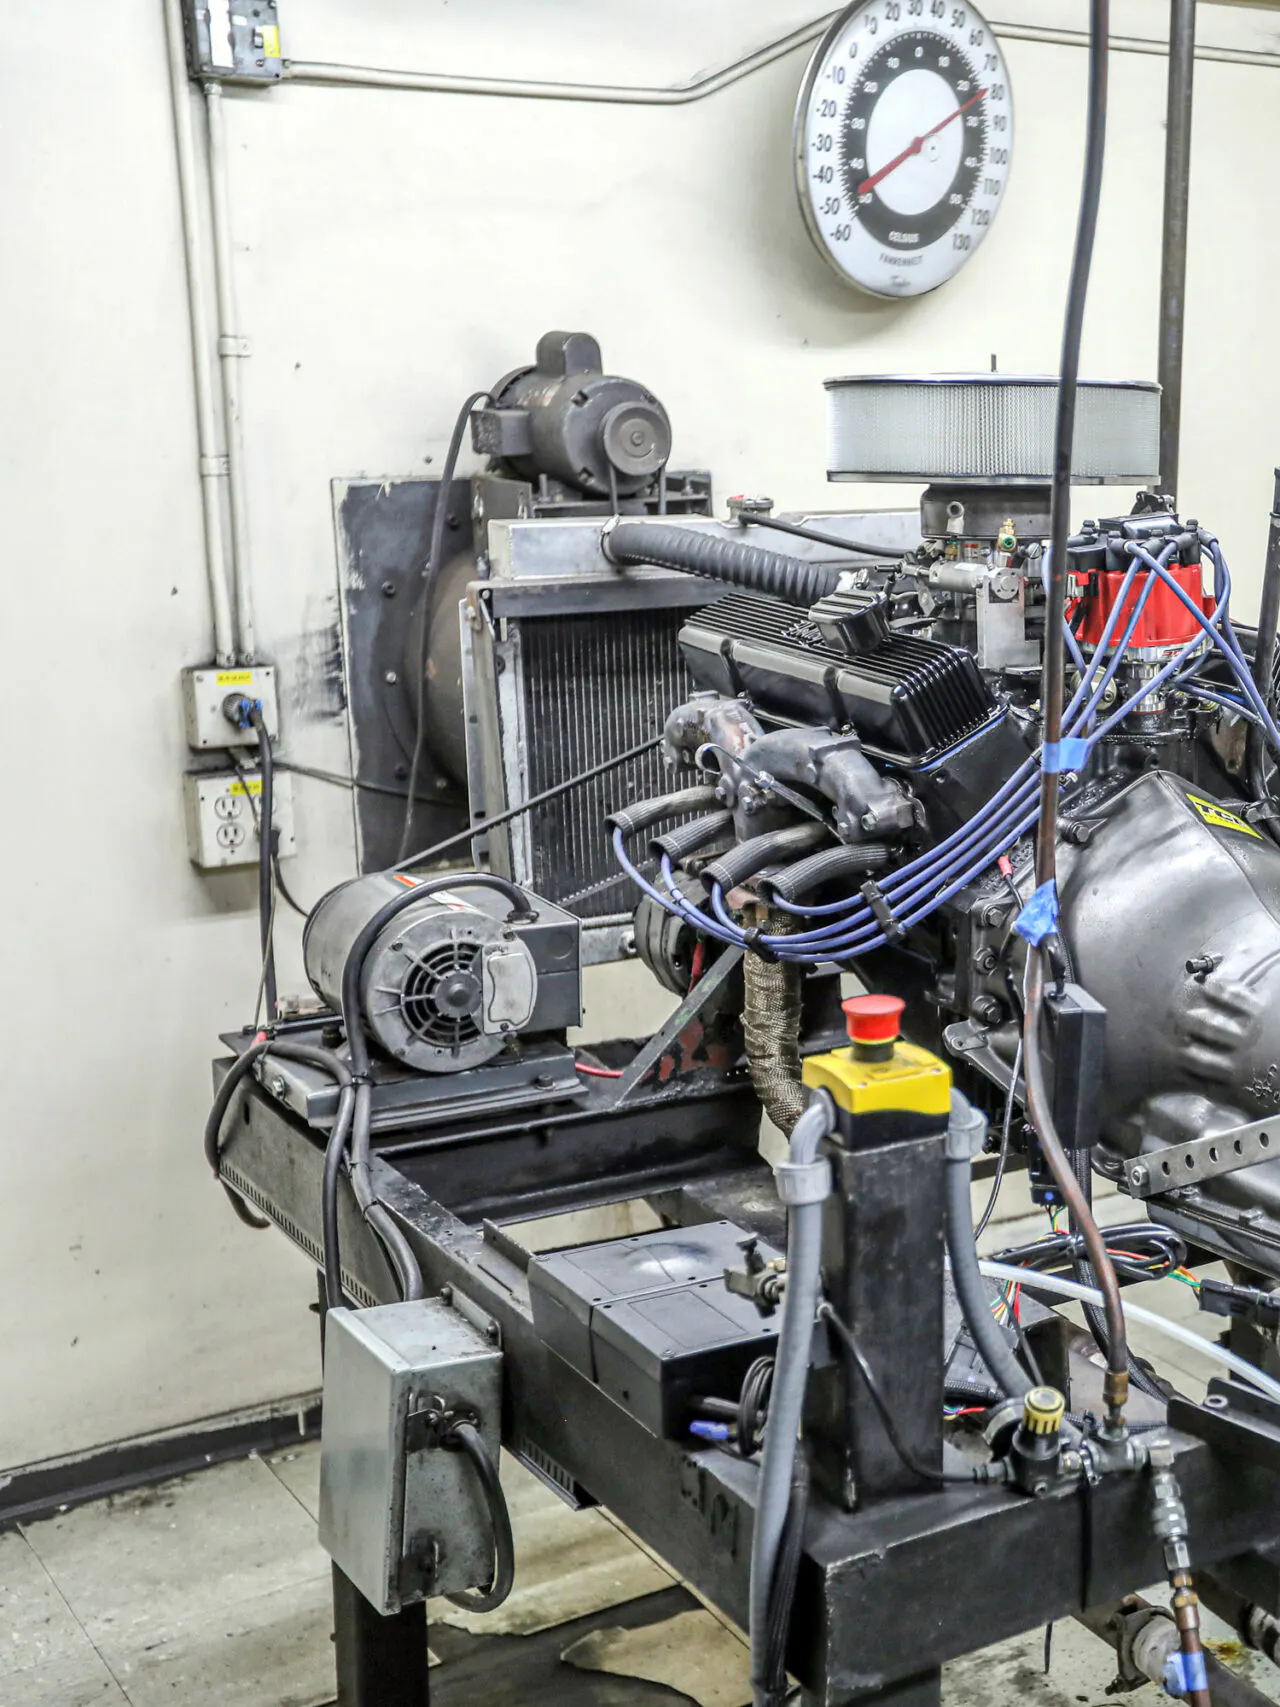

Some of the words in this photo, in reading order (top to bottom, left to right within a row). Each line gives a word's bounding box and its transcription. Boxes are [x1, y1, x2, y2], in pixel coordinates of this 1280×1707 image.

[885, 1, 900, 21] 20
[908, 0, 923, 16] 30
[930, 0, 945, 18] 40
[951, 8, 965, 28] 50
[969, 28, 984, 47] 60
[849, 42, 858, 59] 0
[915, 46, 924, 58] 0
[984, 53, 999, 72] 70
[826, 66, 846, 85] -10
[989, 83, 1005, 101] 80
[816, 99, 837, 118] -20
[811, 133, 833, 152] -30
[989, 147, 1008, 165] 100
[812, 165, 834, 184] -40
[983, 178, 1002, 196] 110
[819, 196, 840, 216] -50
[971, 208, 990, 226] 120
[829, 223, 852, 242] -60
[952, 233, 971, 251] 130
